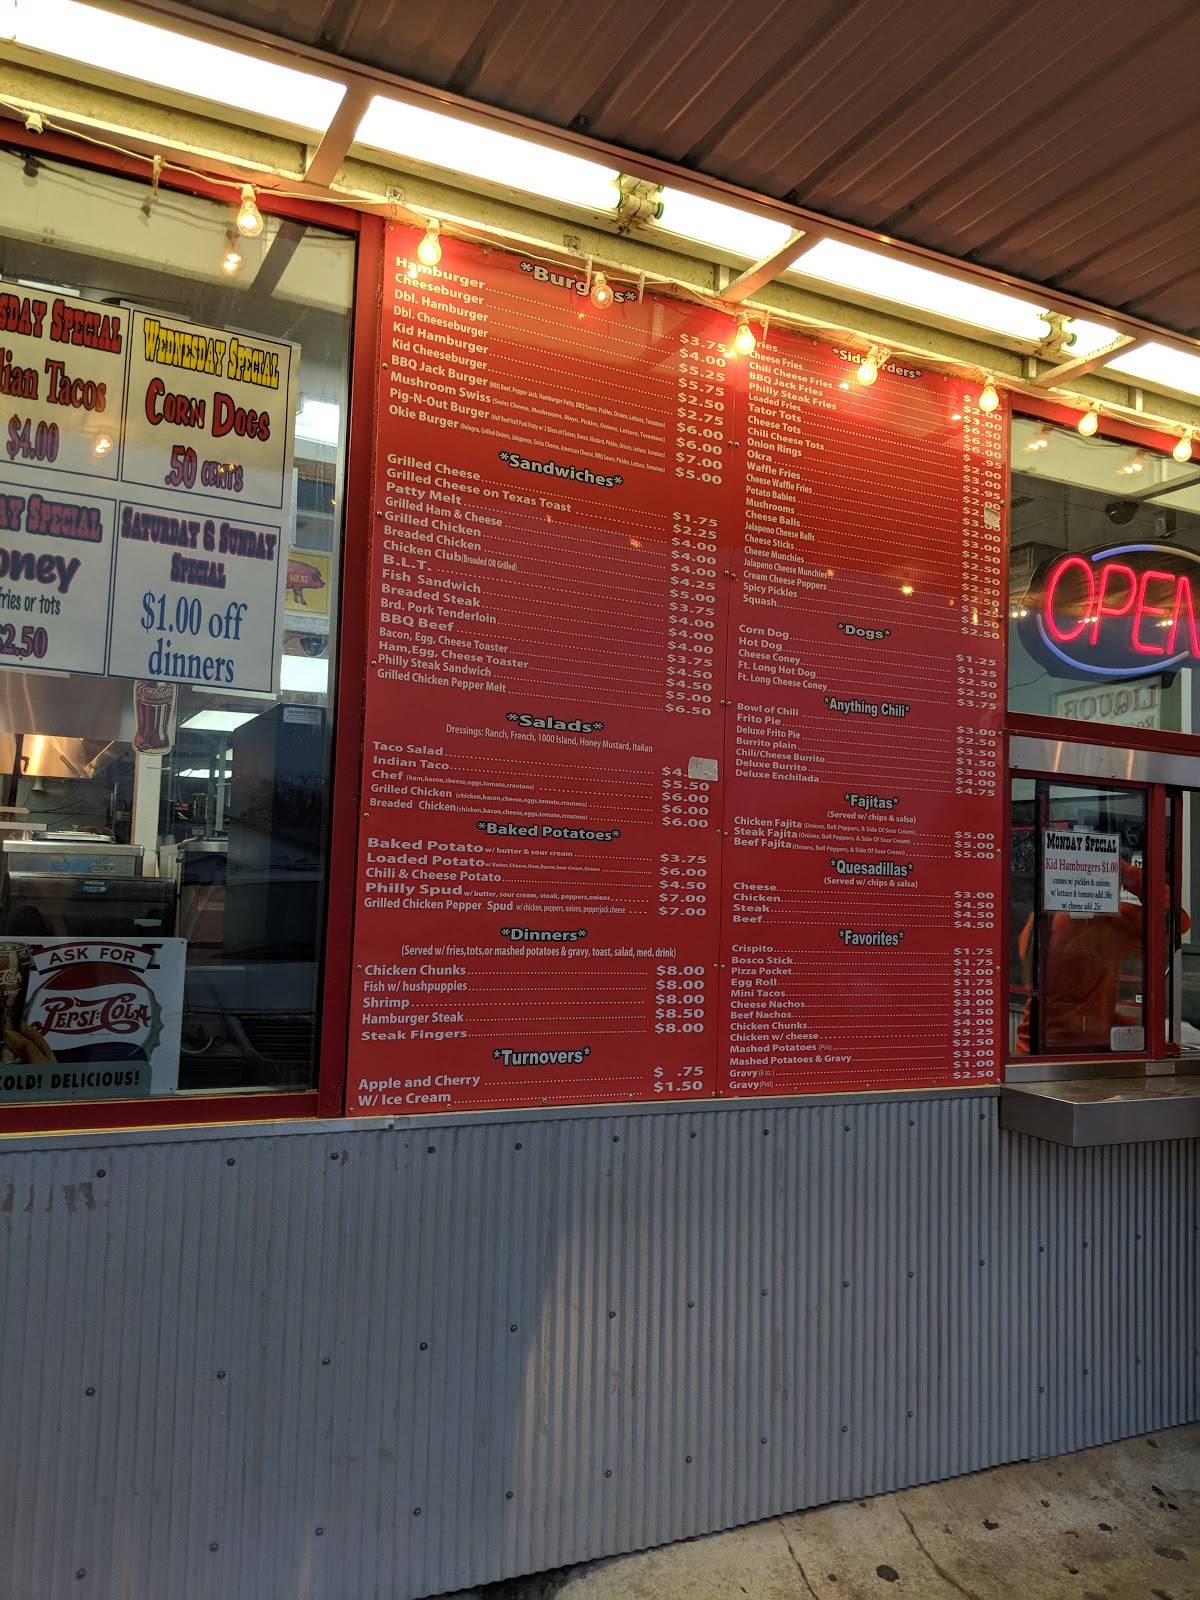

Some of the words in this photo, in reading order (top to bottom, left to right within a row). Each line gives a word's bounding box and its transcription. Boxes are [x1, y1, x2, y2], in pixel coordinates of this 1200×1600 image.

[394, 272, 484, 305] Cheeseburger
[679, 347, 726, 367] $4.00
[394, 288, 418, 304] Dbl.
[421, 295, 489, 322] Hamburger
[678, 362, 725, 382] $5.25
[45, 358, 107, 413] Tacos
[392, 321, 414, 336] Kid
[416, 327, 489, 354] Hamburger
[677, 391, 725, 411] $2.50
[390, 370, 456, 395] Mushroom
[458, 386, 491, 403] Swiss
[675, 436, 722, 455] $6.00
[391, 354, 417, 371] BBQ
[418, 361, 446, 377] Jack
[447, 367, 488, 386] Burger
[676, 421, 724, 441] $6.00
[748, 381, 779, 397] Philly
[780, 390, 810, 404] Steak
[812, 397, 837, 410] Fries
[963, 434, 1001, 450] $6.50
[6, 414, 60, 463] $4.00
[388, 404, 416, 420] Okie
[418, 410, 459, 428] Burger
[674, 466, 722, 485] $5.00
[165, 445, 197, 489] .50
[746, 437, 775, 451] Onion
[776, 443, 802, 458] Rings
[962, 484, 1000, 500] $2.95
[386, 467, 431, 485] Grilled
[434, 477, 480, 495] Cheese
[482, 488, 499, 498] on
[501, 490, 536, 506] Texas
[538, 497, 572, 513] Toast
[672, 523, 717, 540] $2.25
[745, 496, 795, 514] Mushrooms
[961, 538, 1001, 553] $3.00
[24, 596, 37, 612] or
[39, 595, 61, 616] tots
[381, 567, 411, 582] Fish
[417, 574, 481, 594] Sandwich
[668, 614, 714, 629] $4.00
[383, 553, 432, 571] B.L.T.
[669, 601, 714, 616] $3.75
[1046, 556, 1200, 659] OPEN
[141, 590, 202, 636] $1.00
[208, 601, 248, 640] off
[380, 611, 414, 627] BBQ
[418, 617, 454, 631] Beef
[666, 653, 713, 667] $3.75
[742, 593, 777, 607] Squash
[960, 626, 1000, 640] $2.50
[148, 637, 235, 683] dinners
[738, 624, 764, 635] Corn
[767, 627, 789, 641] Dog
[955, 653, 997, 666] $1.25
[446, 723, 484, 738] Dressings:
[484, 727, 509, 740] Ranch,
[510, 730, 536, 742] French,
[538, 733, 555, 743] 1000
[555, 734, 578, 746] Island,
[579, 737, 601, 750] Honey
[602, 739, 631, 752] Mustard,
[632, 742, 653, 752] Italian
[736, 712, 762, 723] Frito
[764, 715, 781, 725] Pie
[956, 735, 996, 747] $2.50
[373, 755, 416, 767] Indian
[419, 759, 449, 770] Taco
[662, 778, 710, 791] $5.50
[823, 876, 854, 885] (Served
[855, 878, 866, 886] w/
[866, 878, 888, 888] chips
[888, 879, 895, 887] &
[896, 879, 918, 889] salsa)
[1045, 858, 1058, 870] Kid
[1059, 859, 1100, 876] Hamburgers
[1101, 861, 1119, 874] $1.00
[1067, 901, 1083, 909] cheese
[50, 947, 88, 965] ASK
[100, 947, 136, 964] FOR
[364, 964, 417, 975] Chicken
[419, 964, 466, 975] Chunks
[656, 964, 705, 976] $8.00
[401, 944, 433, 957] (Served
[434, 945, 445, 956] w/
[494, 945, 525, 956] mashed
[525, 946, 560, 958] potatoes
[560, 945, 567, 956] &
[567, 948, 591, 959] gravy,
[591, 947, 613, 958] toast,
[613, 946, 635, 958] salad,
[636, 946, 654, 957] med.
[655, 947, 676, 959] drink)
[731, 943, 773, 954] Crispito
[953, 947, 994, 955] $1.75
[362, 996, 410, 1010] Shrimp
[655, 993, 705, 1005] $8.00
[0, 1073, 42, 1091] OLD!
[51, 1071, 140, 1088] DELICIOUS!
